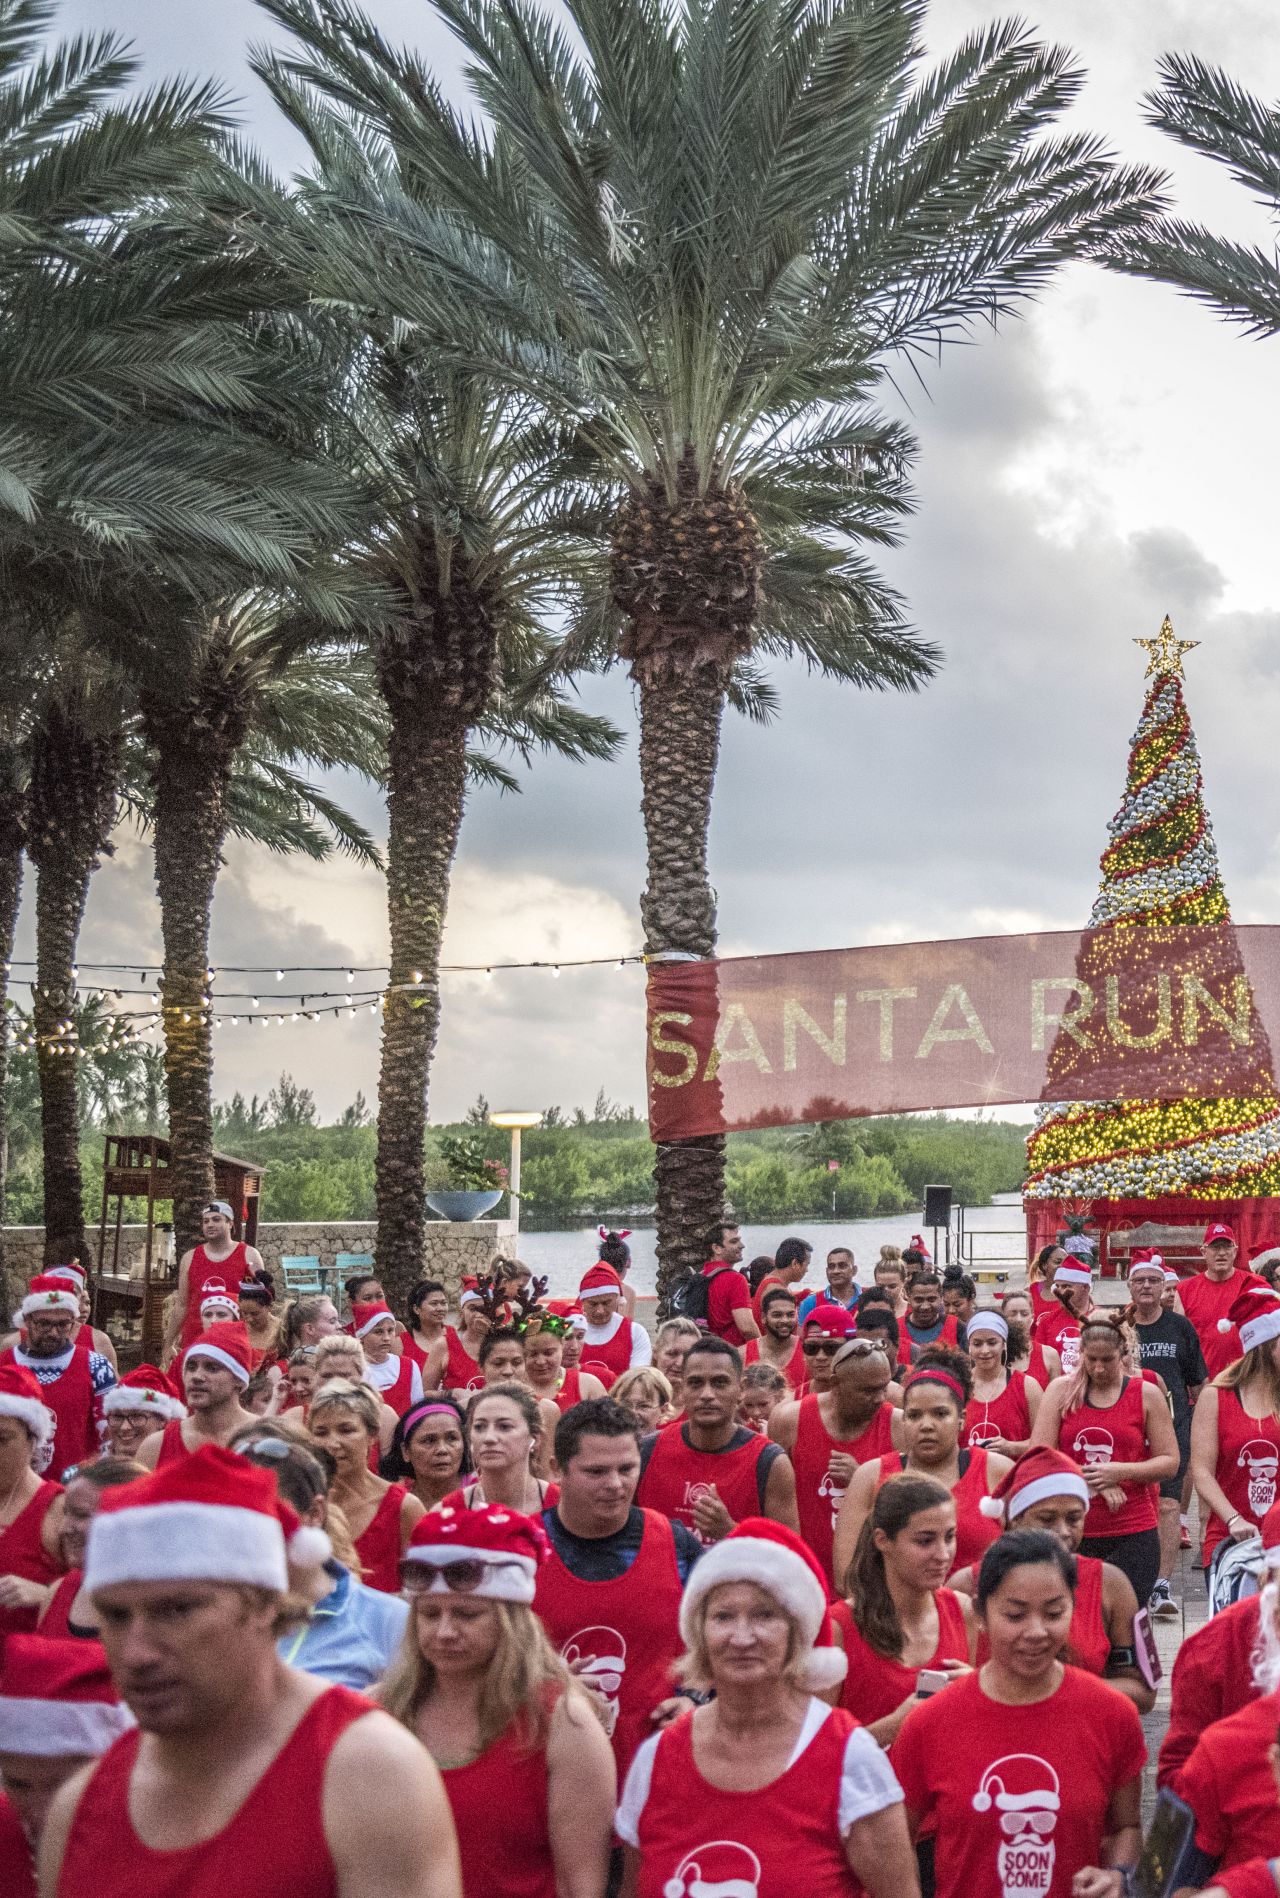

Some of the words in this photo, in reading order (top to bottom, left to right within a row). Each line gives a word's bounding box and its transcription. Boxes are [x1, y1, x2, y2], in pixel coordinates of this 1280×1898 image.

[652, 984, 995, 1088] SANTA
[1031, 973, 1254, 1052] RUN
[1137, 1342, 1177, 1352] NYTIME
[1251, 1485, 1274, 1495] SOON
[1251, 1495, 1272, 1504] COME
[1005, 1851, 1050, 1870] SOON
[1006, 1871, 1048, 1888] COME
